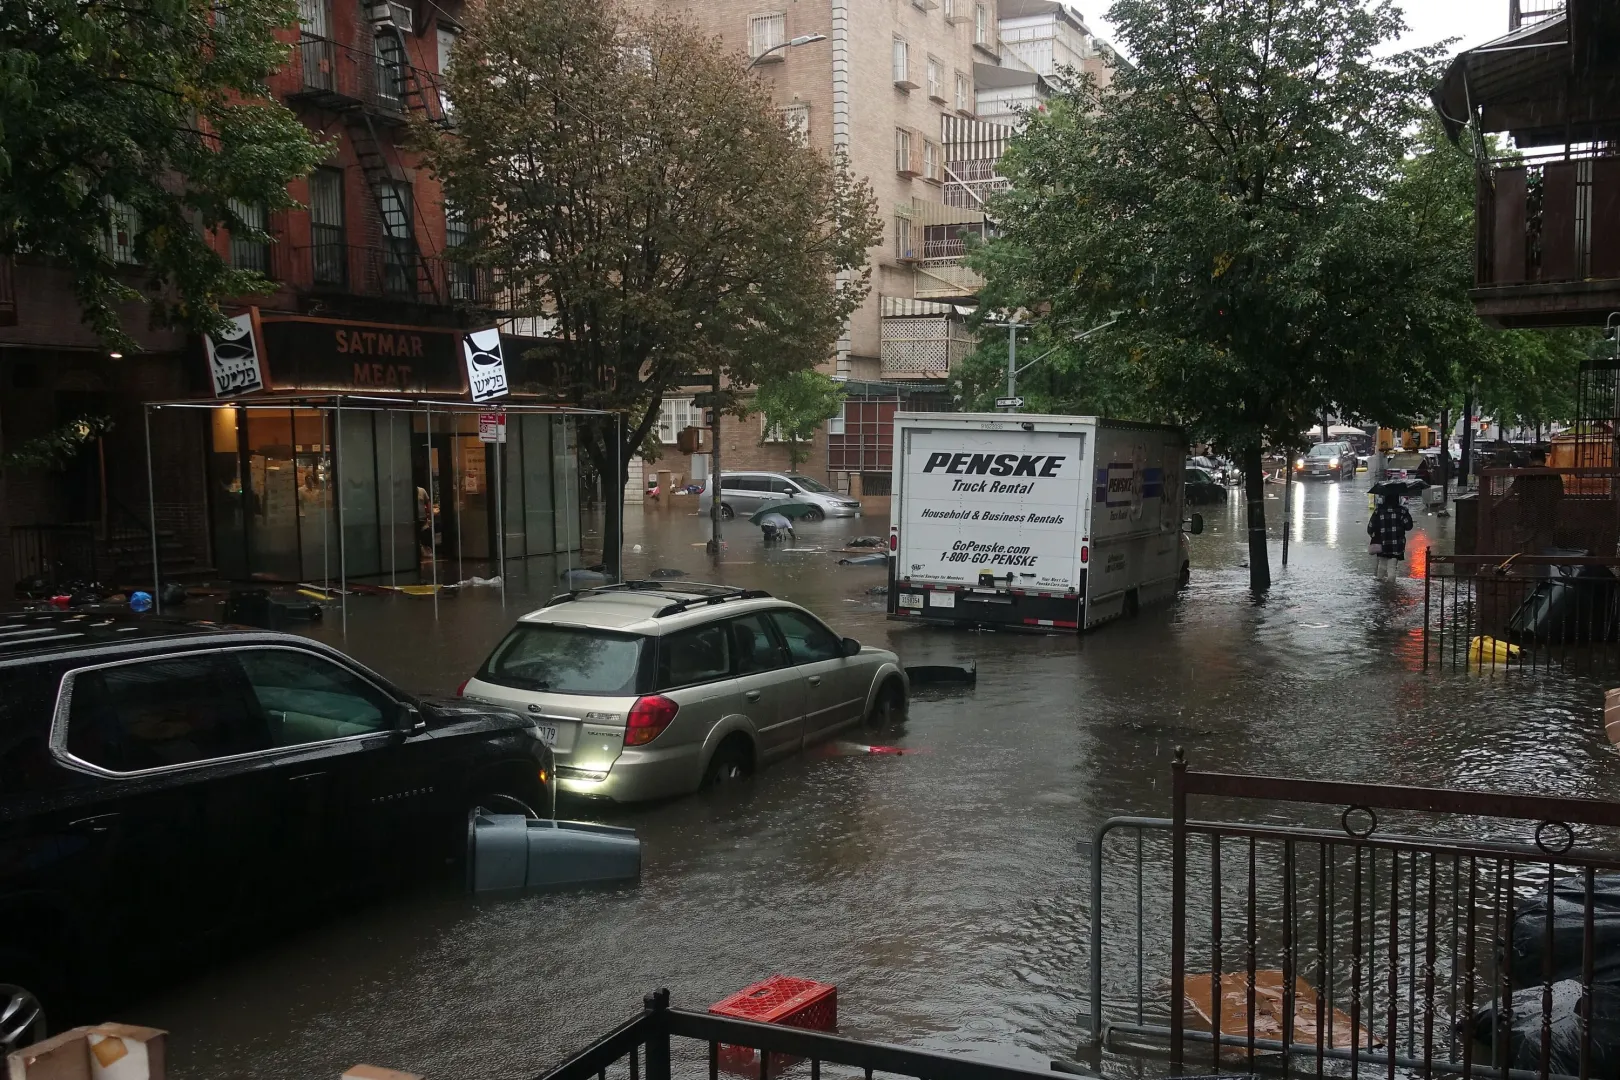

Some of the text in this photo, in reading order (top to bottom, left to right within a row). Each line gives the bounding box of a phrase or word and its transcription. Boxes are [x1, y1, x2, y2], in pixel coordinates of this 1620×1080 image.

[335, 329, 424, 357] SATMAR
[353, 362, 412, 387] MEAT
[923, 452, 1066, 477] PENSKE
[951, 479, 1034, 494] Truck Rental
[921, 508, 1064, 525] Household & Business Rentals
[952, 540, 1030, 555] GoPenske.com
[940, 551, 1038, 567] 1-800-GO-PENSKE
